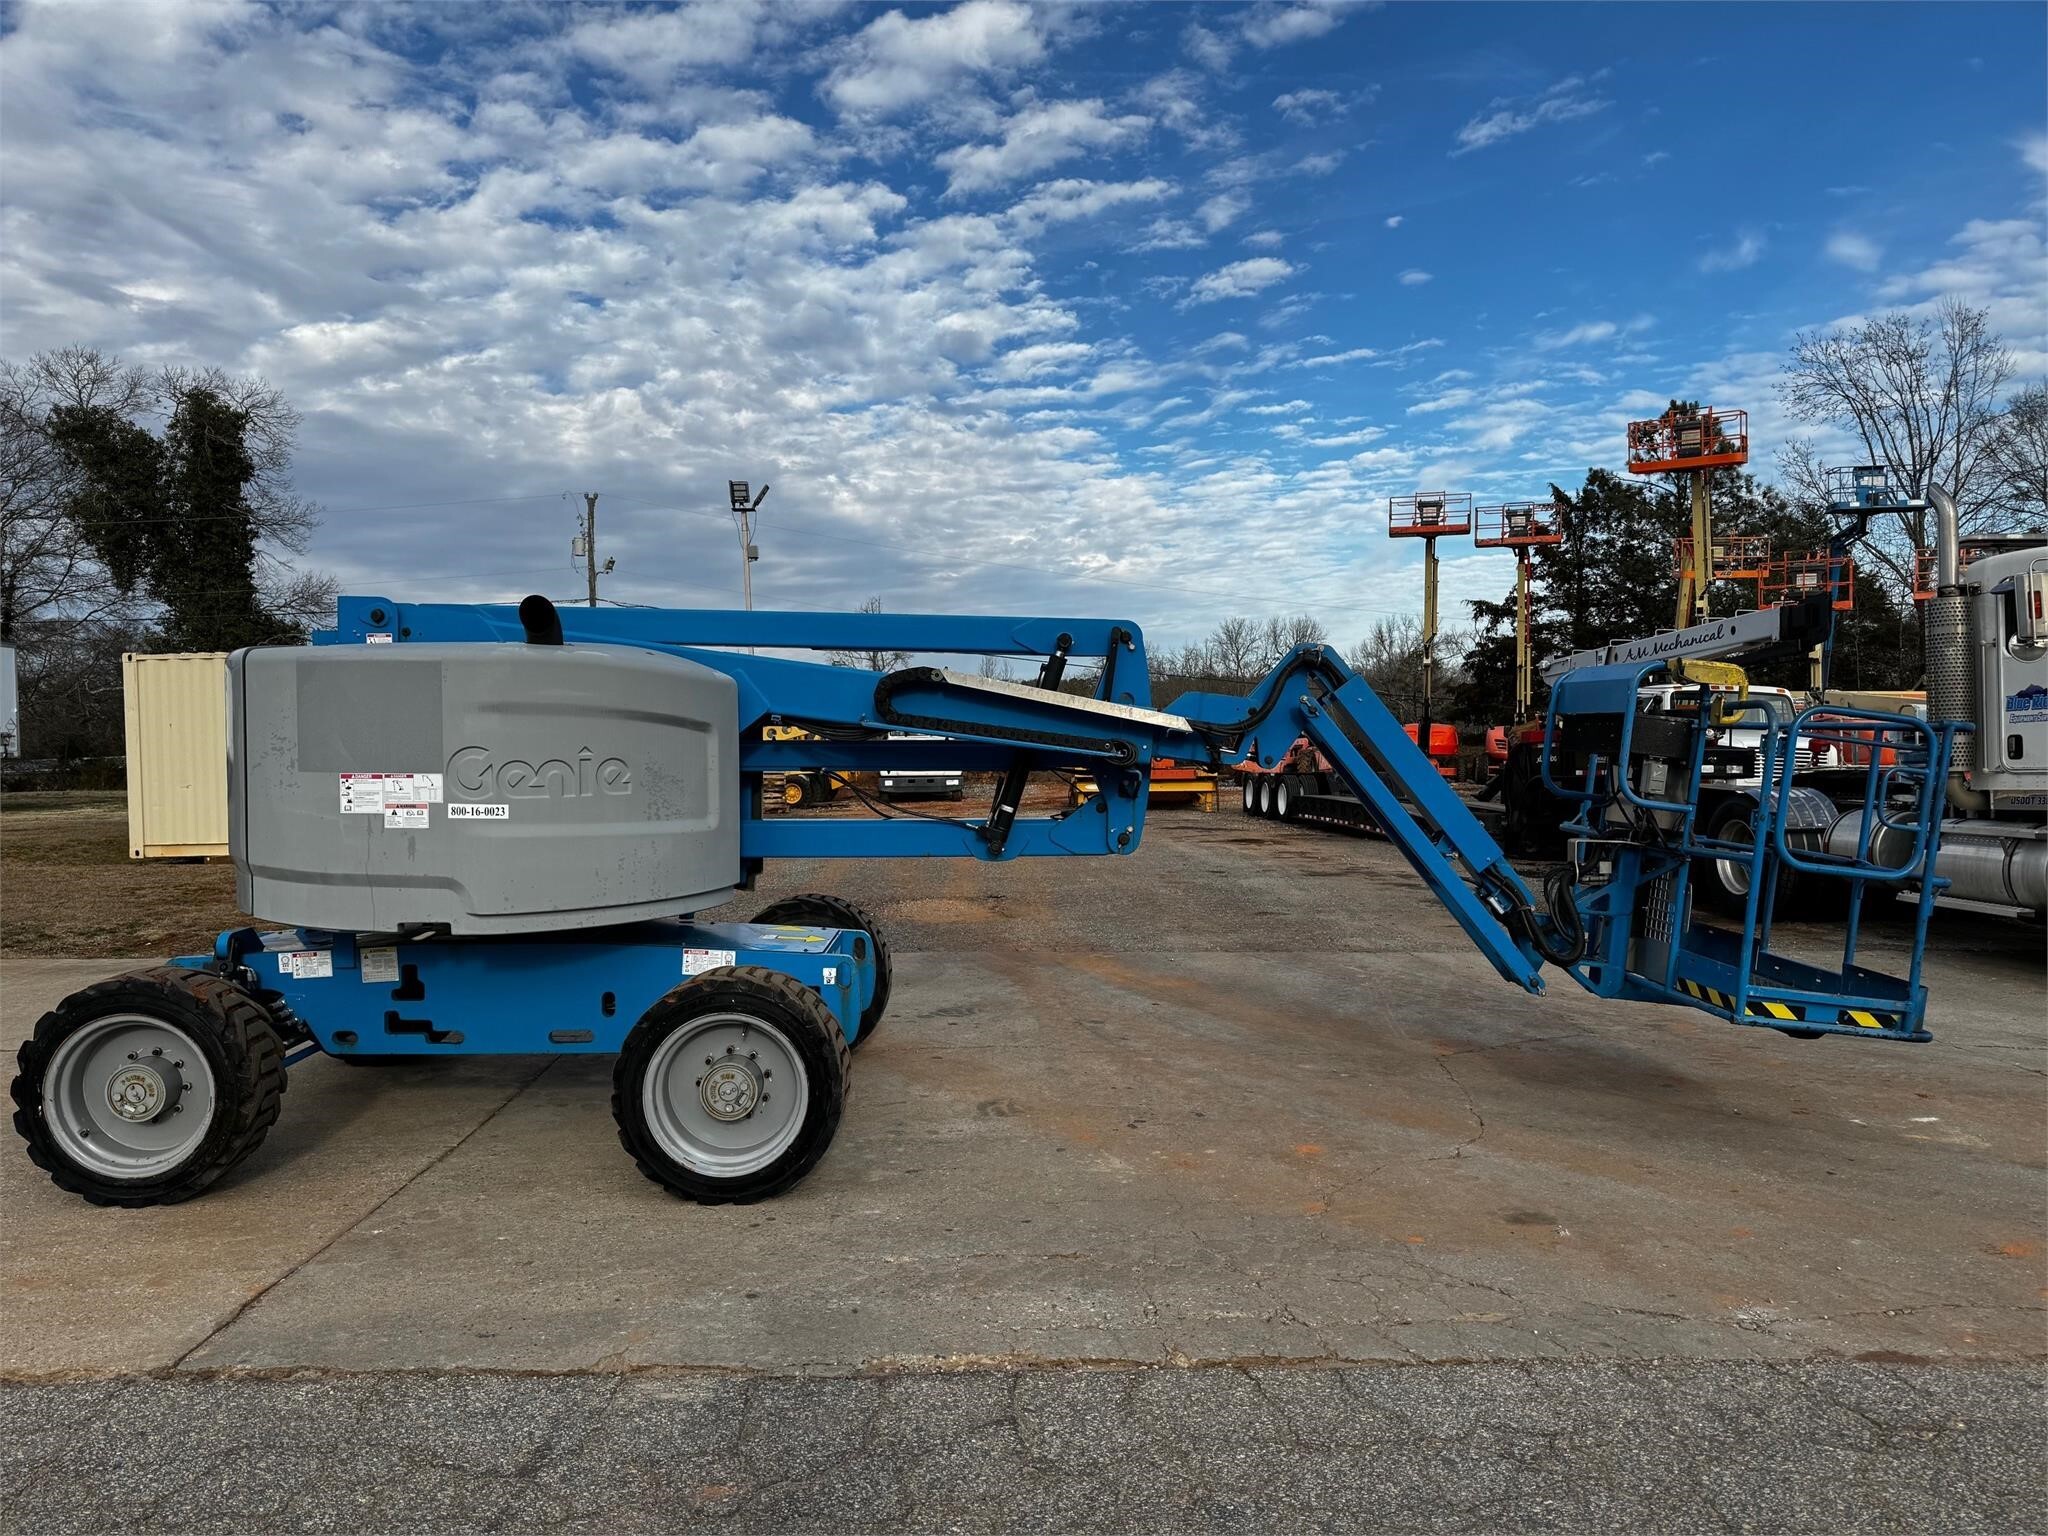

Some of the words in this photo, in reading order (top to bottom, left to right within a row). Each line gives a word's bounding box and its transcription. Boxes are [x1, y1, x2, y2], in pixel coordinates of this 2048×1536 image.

[1622, 647, 1650, 663] AM
[1650, 623, 1725, 656] Mechanical
[2006, 695, 2031, 711] Blue
[446, 746, 631, 800] Genie
[2011, 796, 2035, 805] USDOT
[450, 806, 506, 817] 800-16-0023
